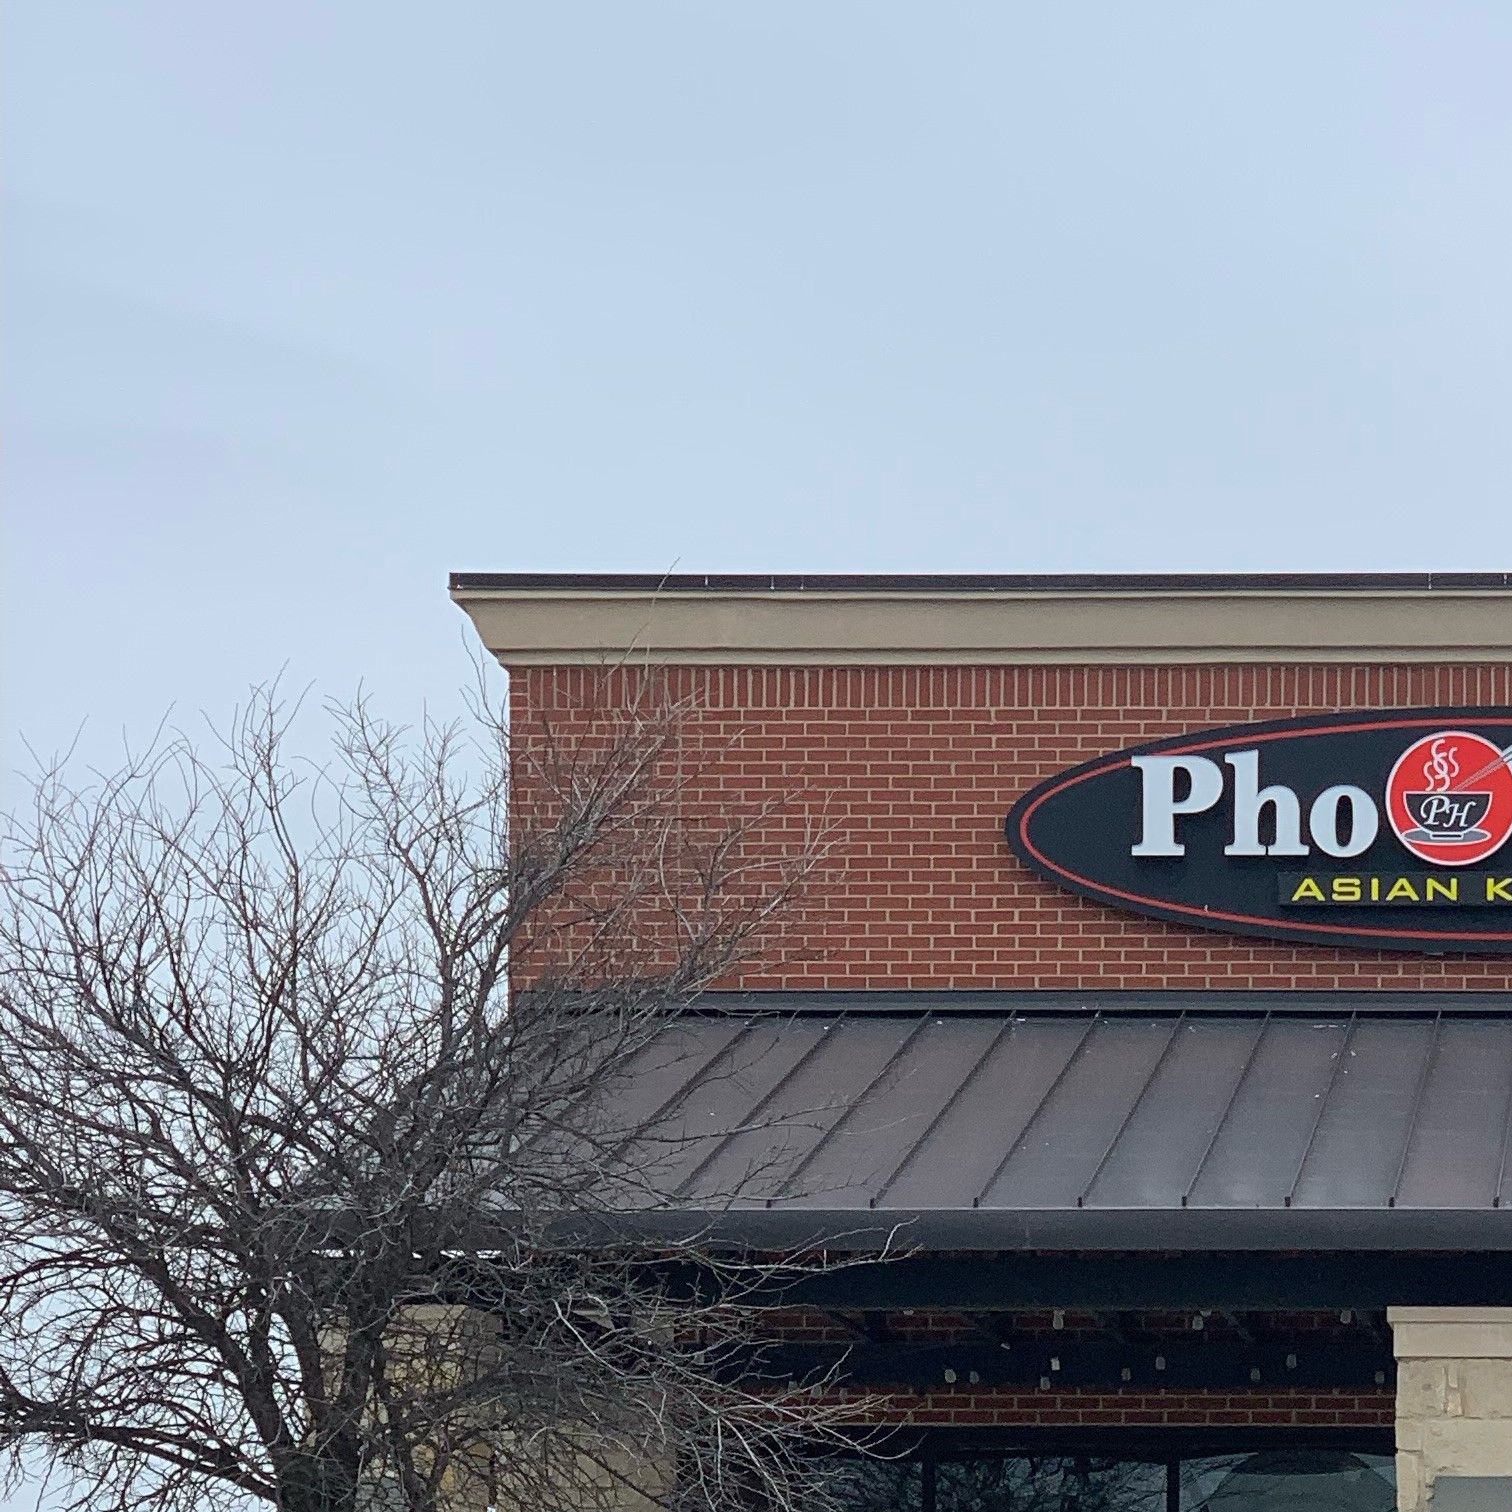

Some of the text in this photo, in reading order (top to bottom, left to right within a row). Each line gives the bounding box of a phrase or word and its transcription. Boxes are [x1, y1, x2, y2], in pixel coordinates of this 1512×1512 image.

[1130, 748, 1379, 858] Pho
[1420, 794, 1478, 829] PH
[1292, 877, 1458, 901] ASIAN
